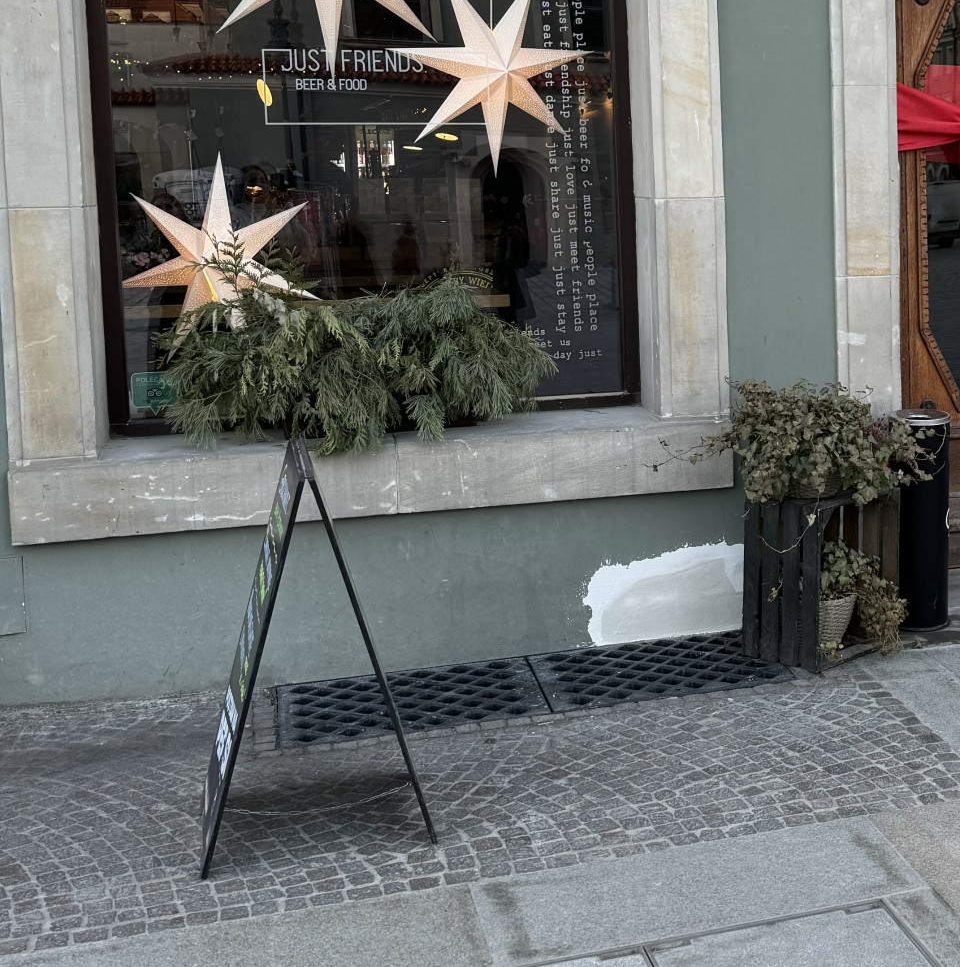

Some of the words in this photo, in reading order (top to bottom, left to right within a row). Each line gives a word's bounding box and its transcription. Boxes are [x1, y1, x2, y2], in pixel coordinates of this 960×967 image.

[556, 2, 568, 32] just
[543, 24, 553, 48] eat
[281, 49, 335, 72] JUST
[341, 49, 424, 73] FRIENDS
[573, 33, 586, 72] plce
[295, 78, 325, 91] BEER
[327, 78, 337, 91] &
[339, 78, 368, 91] FOOD
[545, 65, 555, 87] ust
[563, 127, 574, 157] just
[579, 118, 590, 149] beer
[546, 142, 558, 173] just
[565, 165, 576, 195] love
[550, 181, 561, 219] share
[583, 194, 594, 233] music
[565, 204, 578, 234] just
[550, 228, 563, 257] just
[569, 241, 580, 272] meet
[553, 266, 566, 295] just
[556, 303, 567, 334] stay
[572, 280, 584, 332] friends
[586, 293, 599, 331] place
[553, 351, 572, 360] day
[579, 349, 602, 360] just
